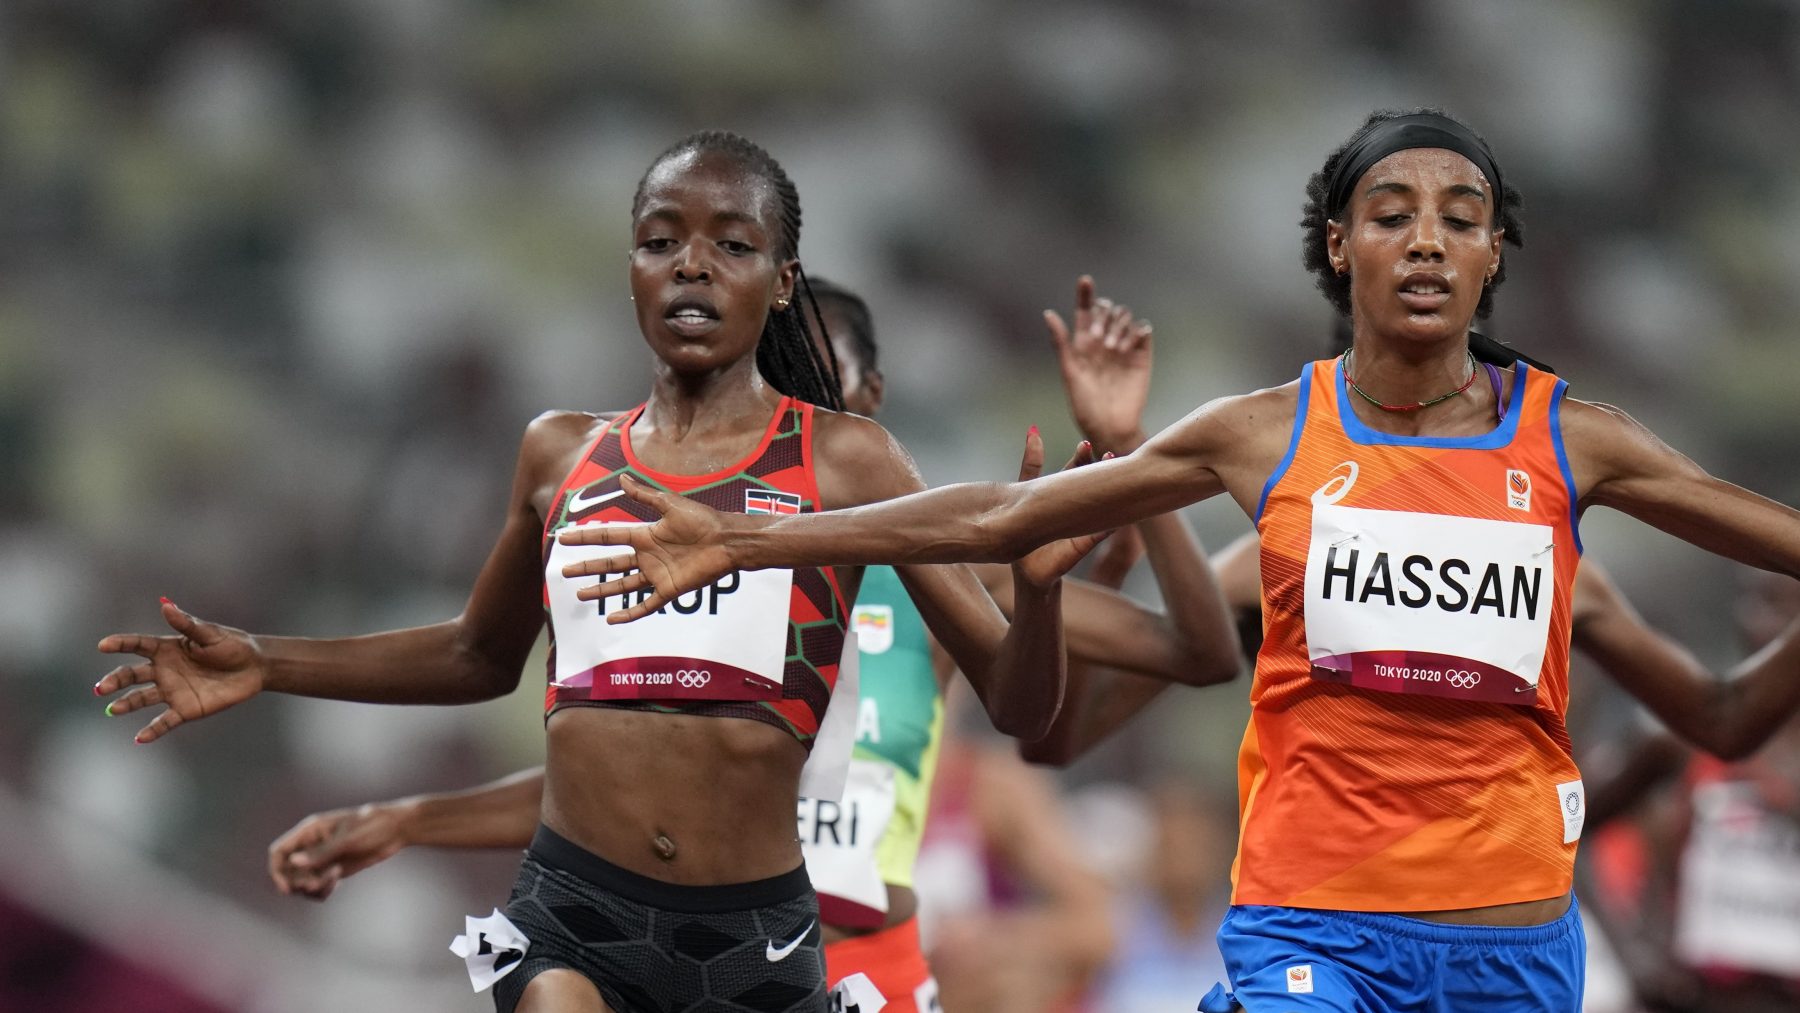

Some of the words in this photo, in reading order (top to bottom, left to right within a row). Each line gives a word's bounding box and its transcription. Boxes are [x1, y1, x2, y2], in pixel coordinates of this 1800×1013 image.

[1322, 547, 1542, 621] HASSAN
[610, 673, 643, 685] TOKYO
[645, 672, 673, 685] 2020
[1374, 664, 1410, 679] TOKYO
[1412, 669, 1441, 682] 2020
